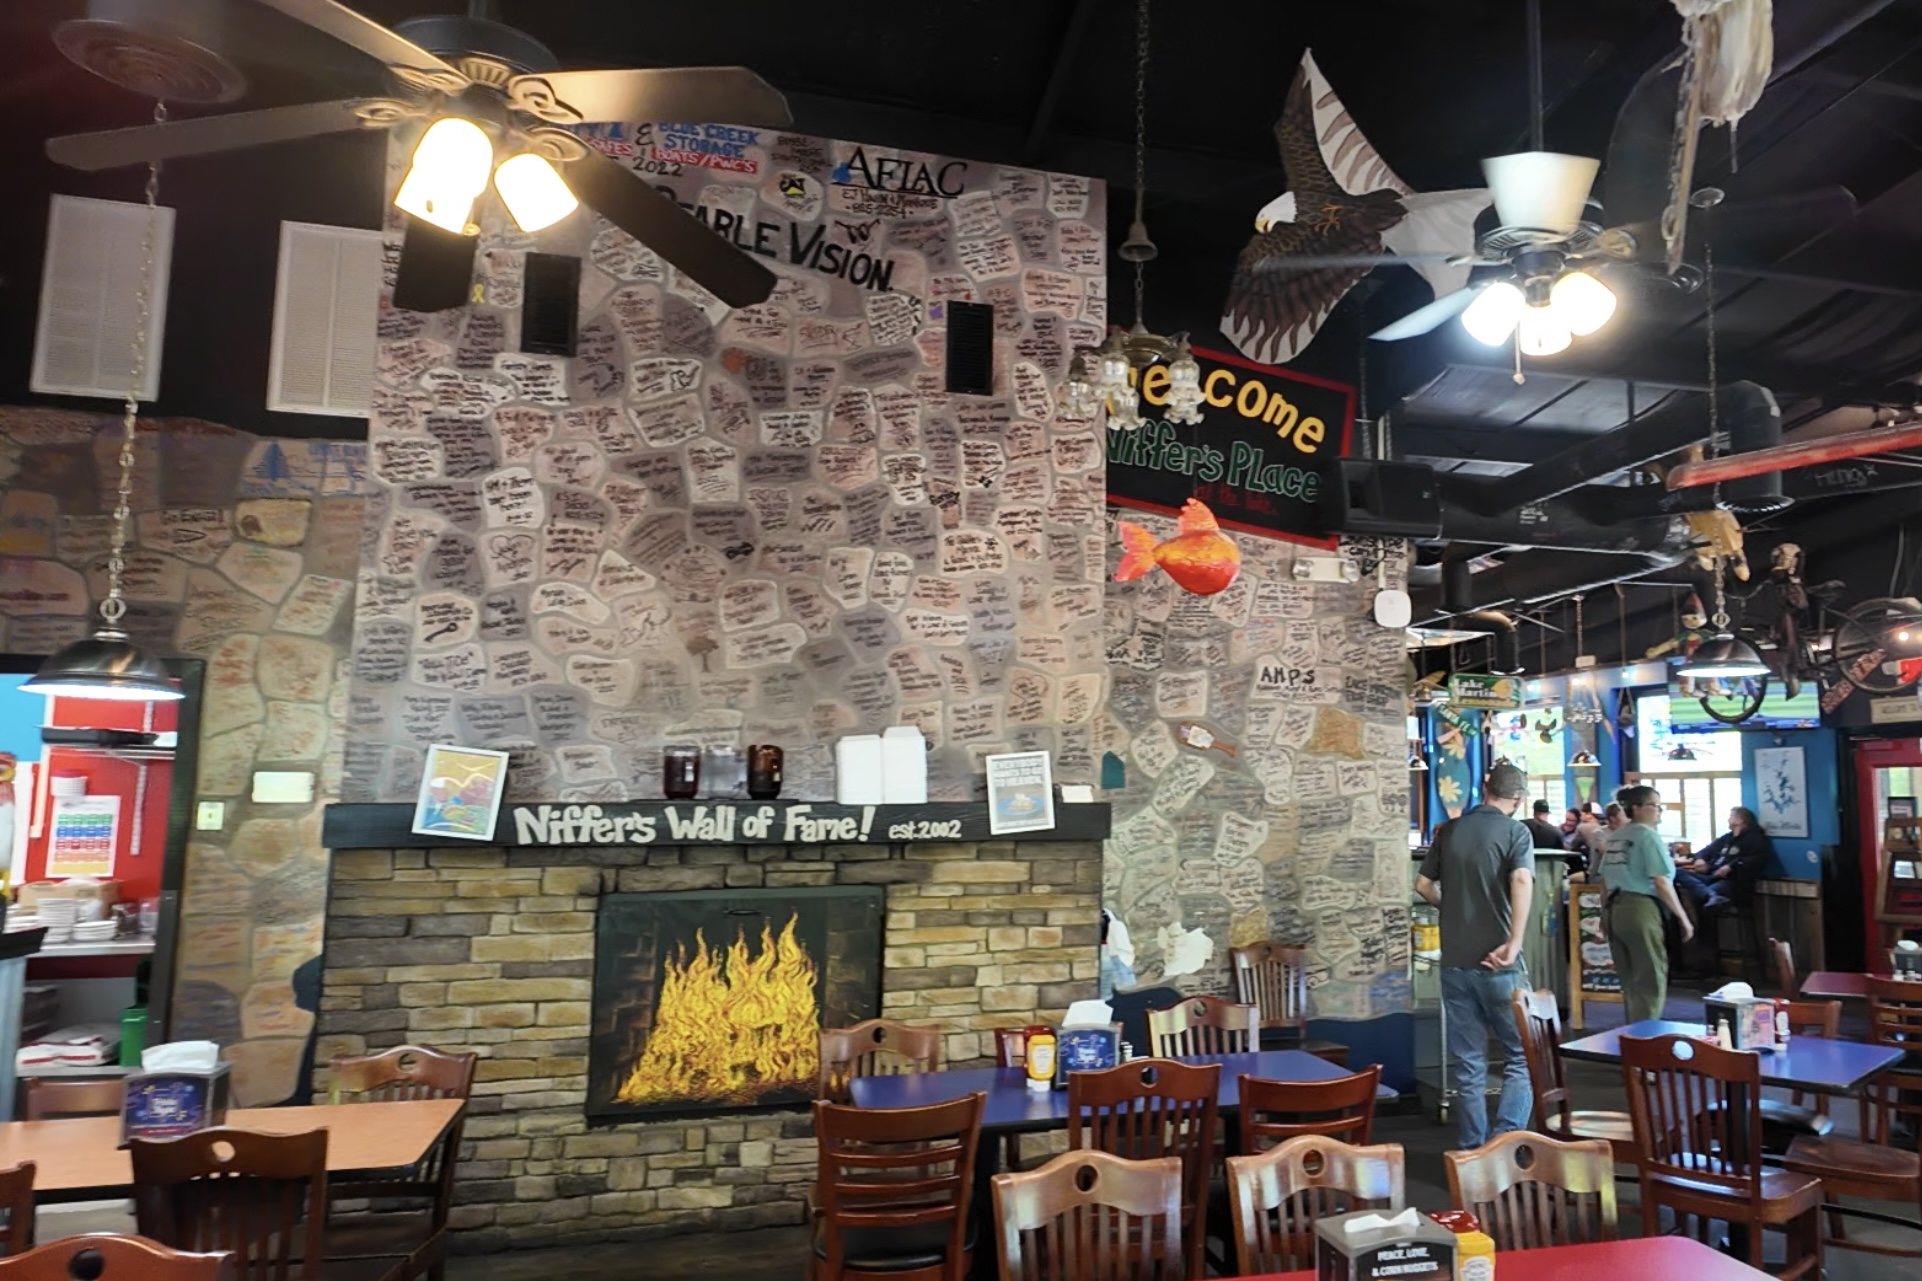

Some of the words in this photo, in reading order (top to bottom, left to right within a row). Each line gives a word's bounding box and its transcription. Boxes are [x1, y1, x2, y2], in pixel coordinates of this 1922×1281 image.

[659, 121, 700, 136] BLUE
[704, 124, 760, 146] CREEK
[664, 134, 745, 158] STORAGE
[633, 156, 683, 177] 2022
[1261, 666, 1316, 686] AMPS
[1454, 679, 1485, 689] Lake
[1454, 687, 1497, 698] Martin
[513, 804, 656, 845] Niffer's
[664, 805, 737, 843] Wall
[743, 805, 775, 839] of
[783, 804, 877, 843] Fame!
